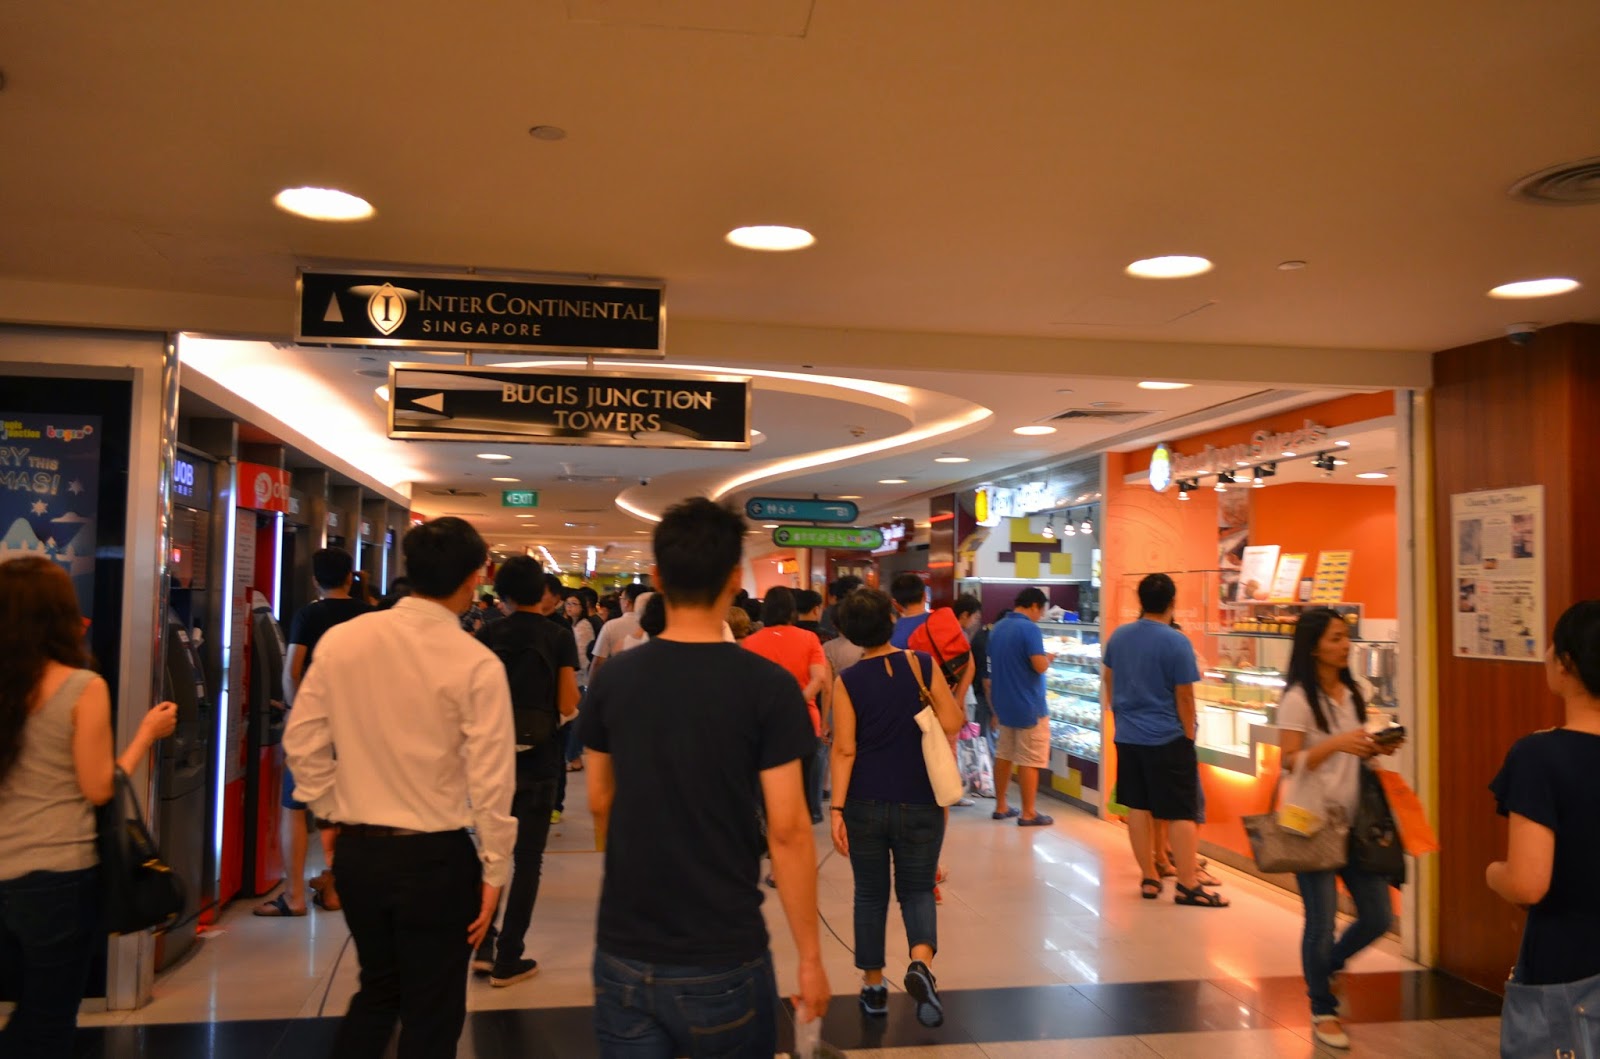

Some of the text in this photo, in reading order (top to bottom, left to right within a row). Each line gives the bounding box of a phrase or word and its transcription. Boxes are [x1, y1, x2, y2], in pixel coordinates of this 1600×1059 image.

[418, 290, 650, 321] INTERCONTINENTAL
[422, 319, 542, 337] SINGAPORE
[501, 384, 713, 411] BUGIS JUNCTION
[553, 410, 661, 431] TOWERS
[28, 456, 59, 470] THIS
[512, 493, 534, 505] EXIT
